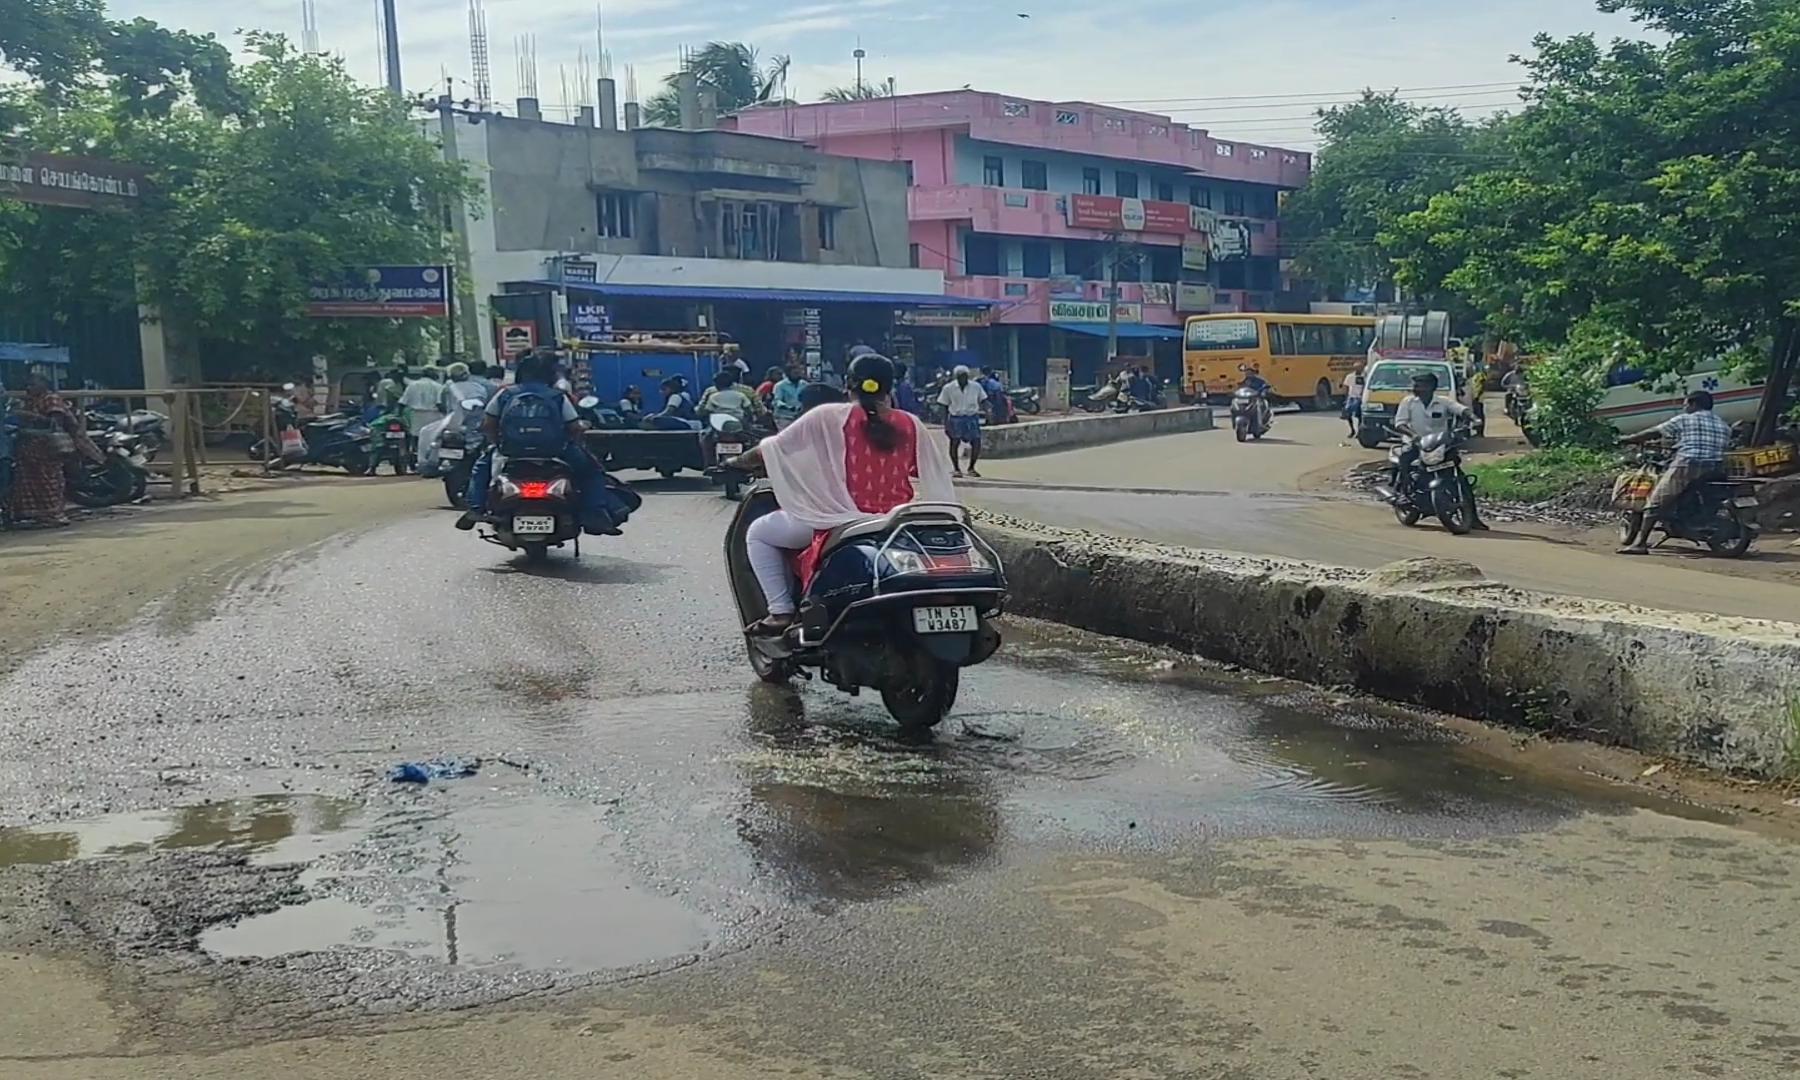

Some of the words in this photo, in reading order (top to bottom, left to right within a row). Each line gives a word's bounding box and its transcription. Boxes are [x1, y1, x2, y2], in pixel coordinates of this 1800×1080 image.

[578, 305, 605, 315] LKR
[926, 607, 943, 619] TN
[950, 607, 966, 618] 61
[927, 618, 967, 631] W3487
